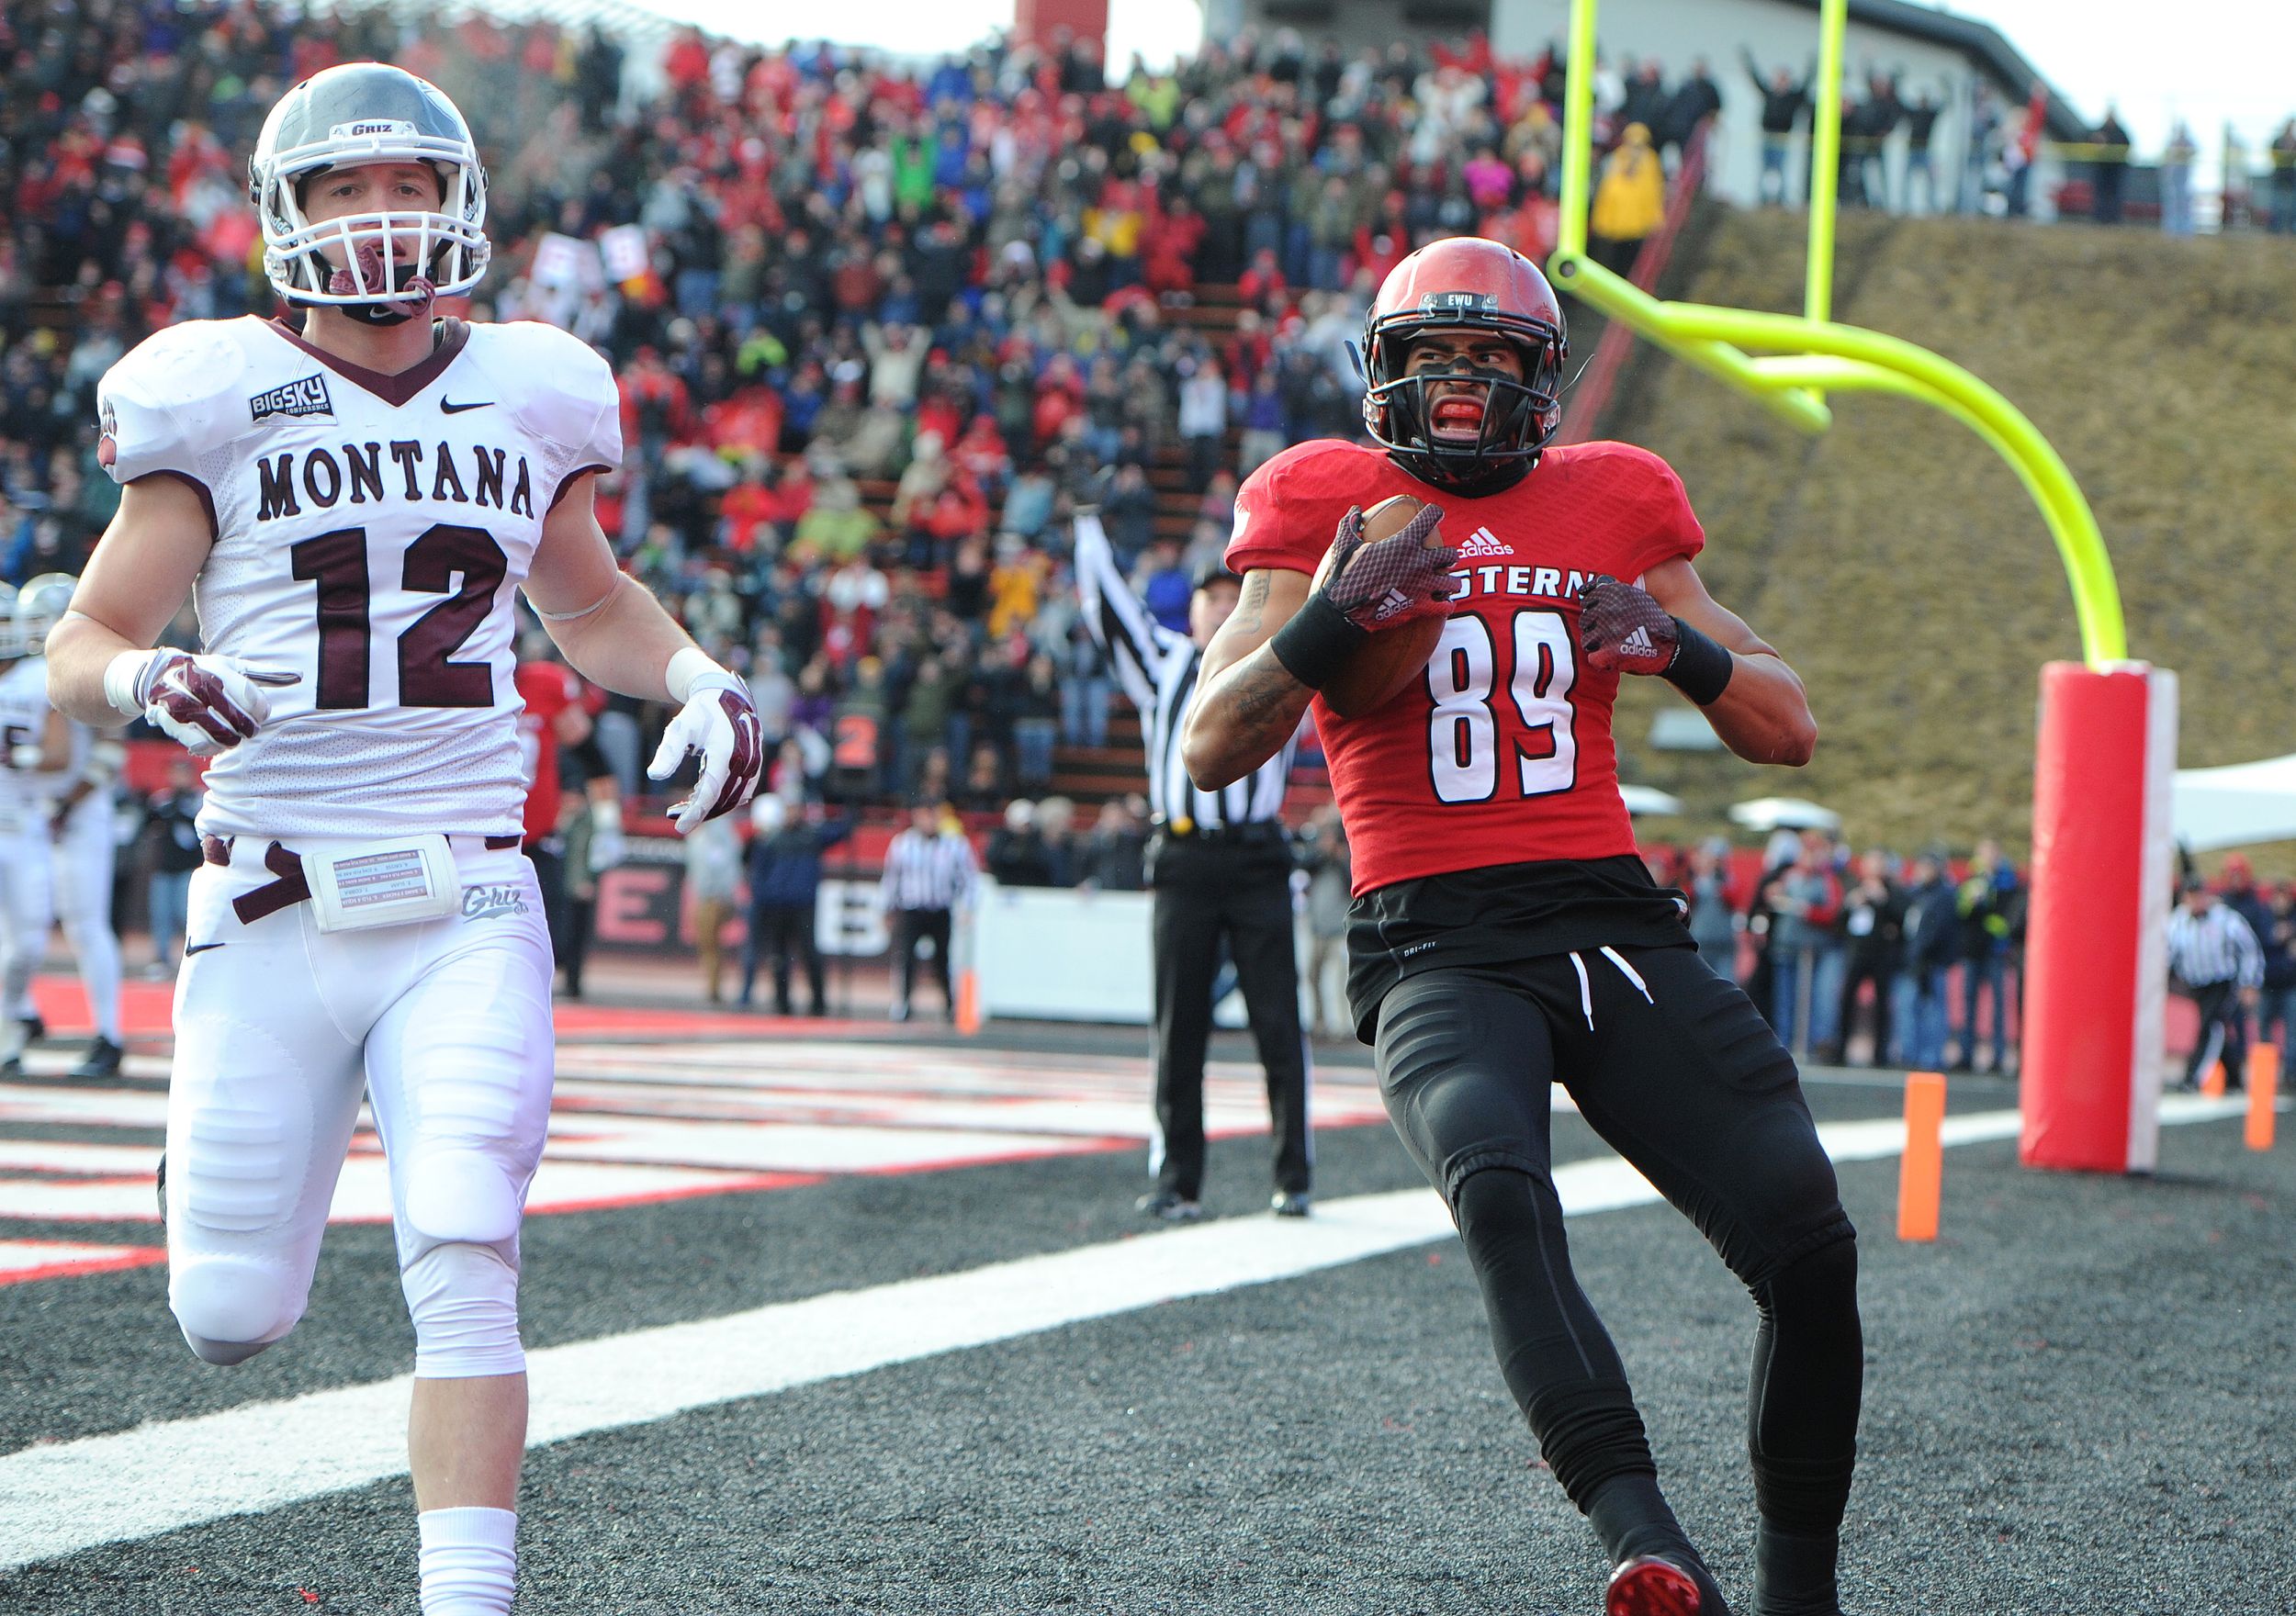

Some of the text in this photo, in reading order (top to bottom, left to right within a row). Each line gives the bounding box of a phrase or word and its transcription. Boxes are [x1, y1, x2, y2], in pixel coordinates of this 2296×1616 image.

[1447, 294, 1473, 307] EWU
[256, 440, 535, 522] MONTANA
[1457, 543, 1514, 559] adidas
[290, 523, 508, 710] 12
[1375, 599, 1415, 621] adidas
[1619, 643, 1659, 657] adidas
[1424, 607, 1579, 805] 89
[1403, 940, 1437, 958] DRI-FIT
